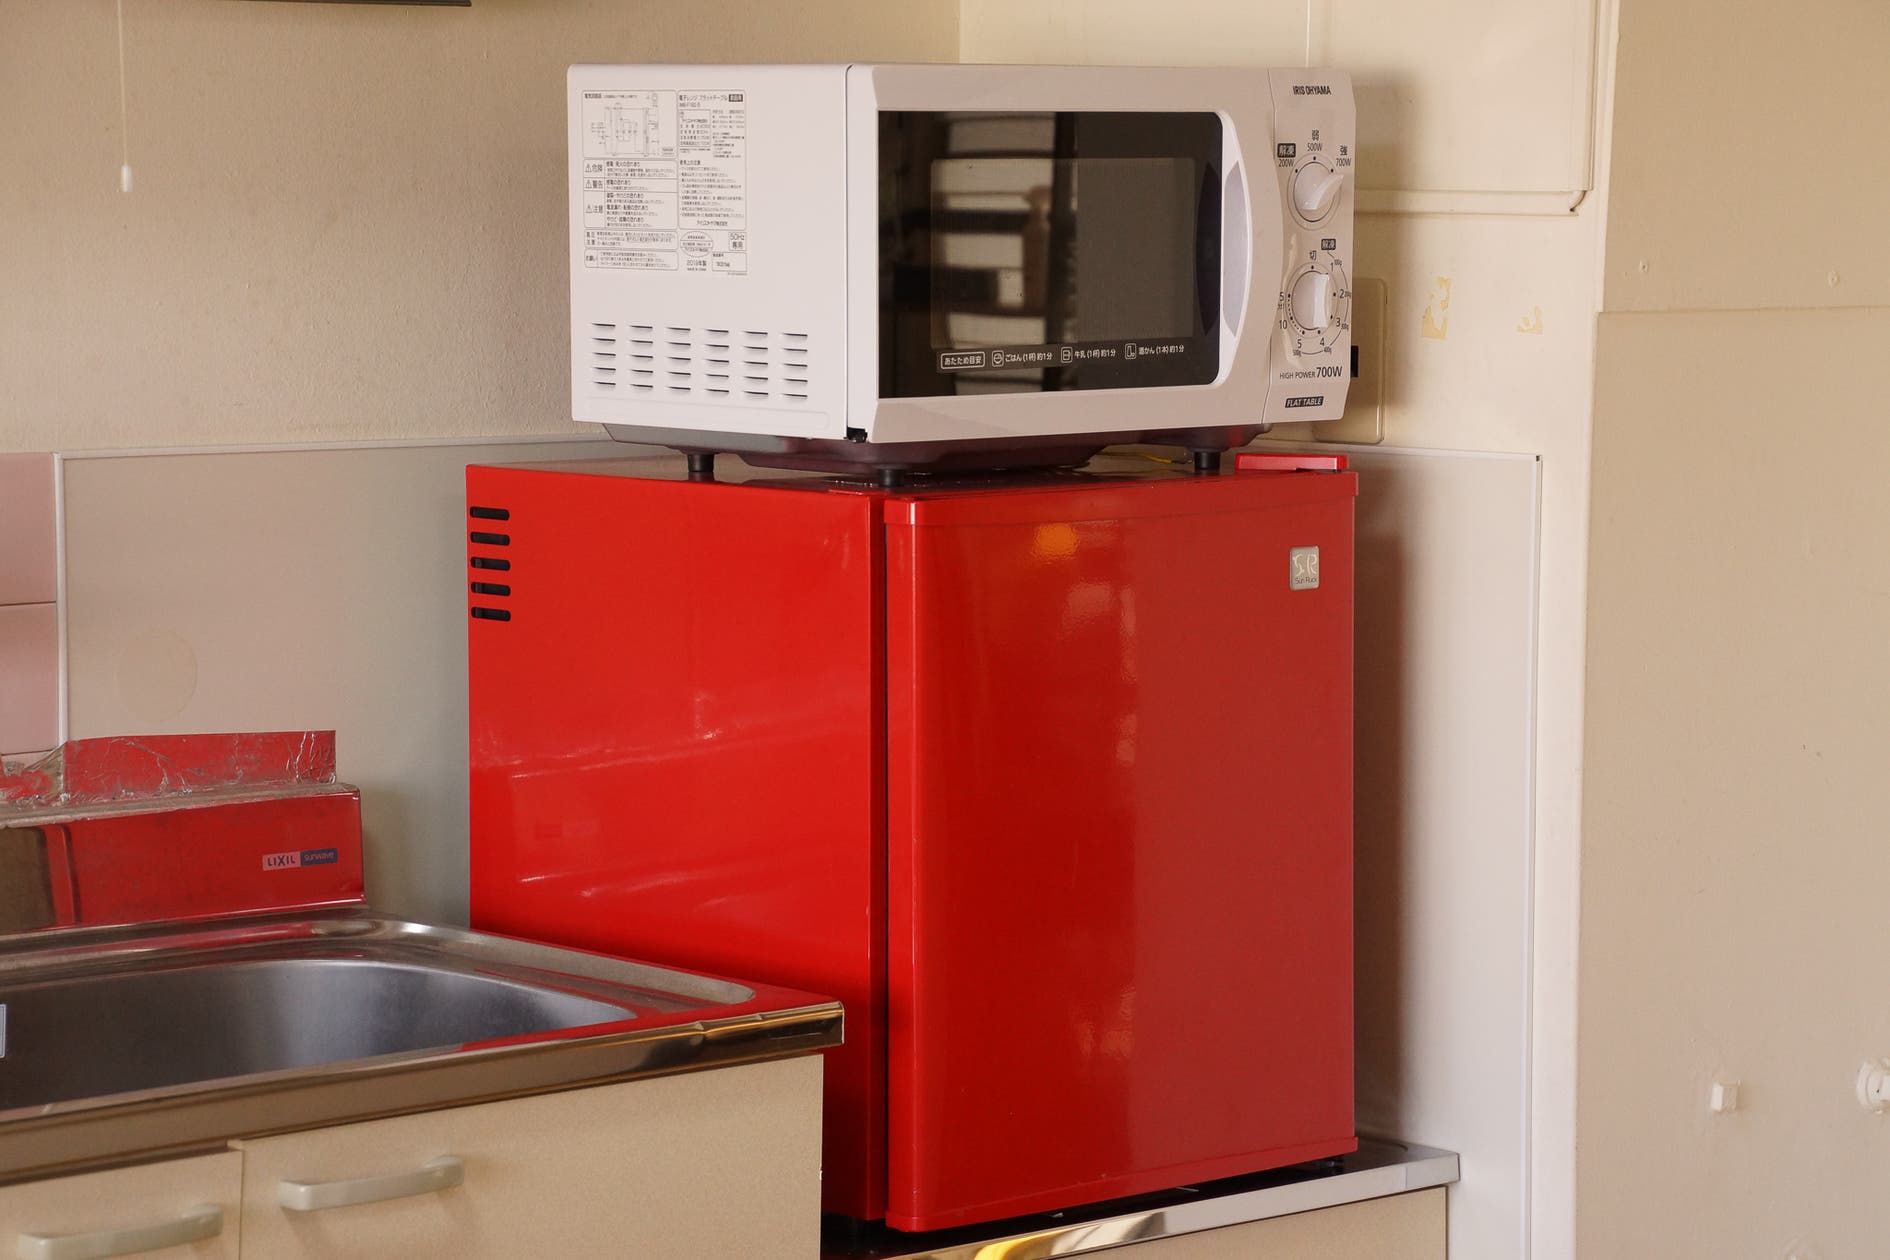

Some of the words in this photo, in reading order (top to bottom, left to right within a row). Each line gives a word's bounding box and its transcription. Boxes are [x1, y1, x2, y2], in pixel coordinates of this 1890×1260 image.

[1293, 85, 1305, 95] IRIS
[1305, 85, 1332, 95] OHYAMA
[1307, 142, 1323, 152] 500W
[1278, 158, 1295, 168] 200W
[1336, 157, 1352, 167] 700W
[729, 232, 745, 241] 50Hz
[1309, 250, 1317, 261] 切
[1330, 262, 1334, 272] 1
[1279, 291, 1285, 302] 5
[1339, 289, 1345, 299] 2
[1278, 319, 1288, 330] 10
[1335, 317, 1341, 328] 3
[1297, 338, 1302, 349] 5
[1319, 336, 1325, 347] 4
[1279, 371, 1294, 380] HIGH
[1295, 370, 1316, 379] POWER
[1316, 366, 1343, 378] 700W
[1286, 399, 1302, 408] FLAT
[1303, 397, 1323, 406] TABLE
[267, 855, 296, 867] LIXIL
